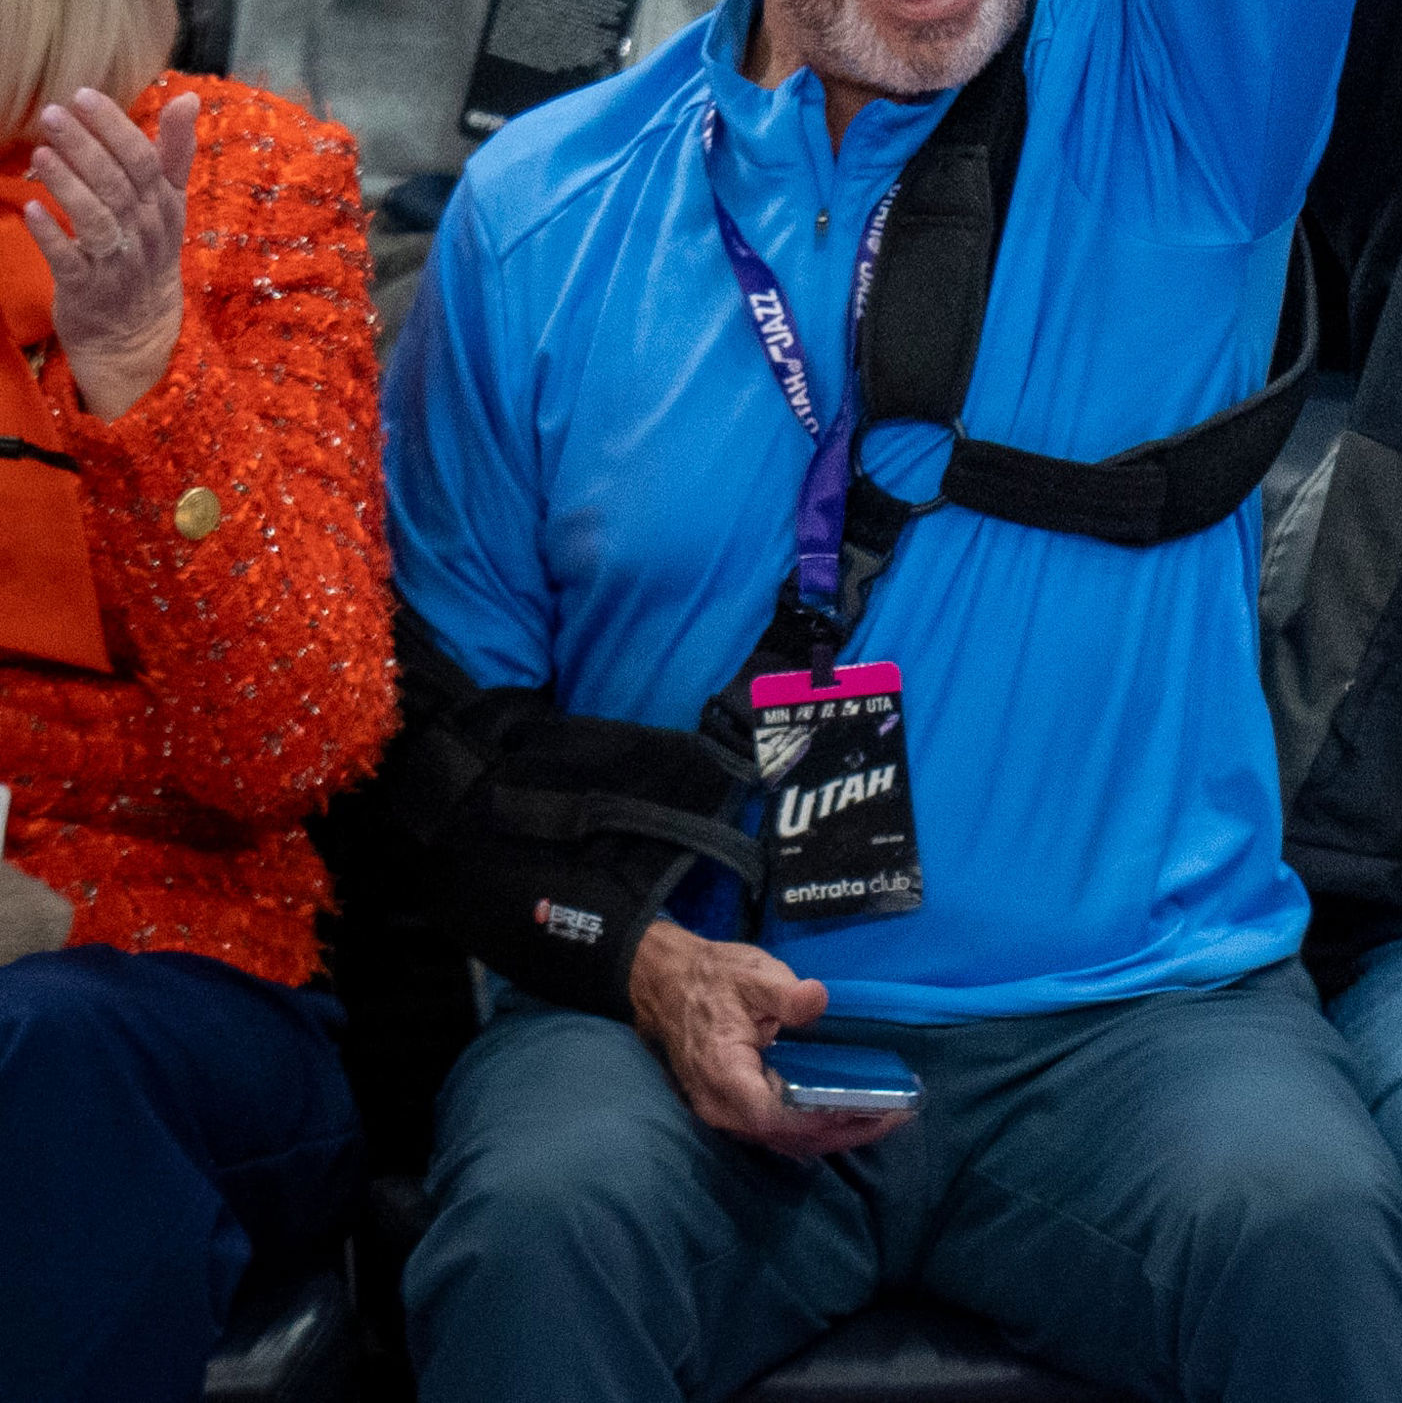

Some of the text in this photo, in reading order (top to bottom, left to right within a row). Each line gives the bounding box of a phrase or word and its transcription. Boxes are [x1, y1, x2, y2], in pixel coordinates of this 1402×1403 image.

[749, 288, 820, 434] UTAH JAZZ
[764, 707, 791, 725] MIN
[865, 696, 893, 713] UTA
[777, 764, 897, 839] UTAH
[784, 869, 912, 904] entrata club
